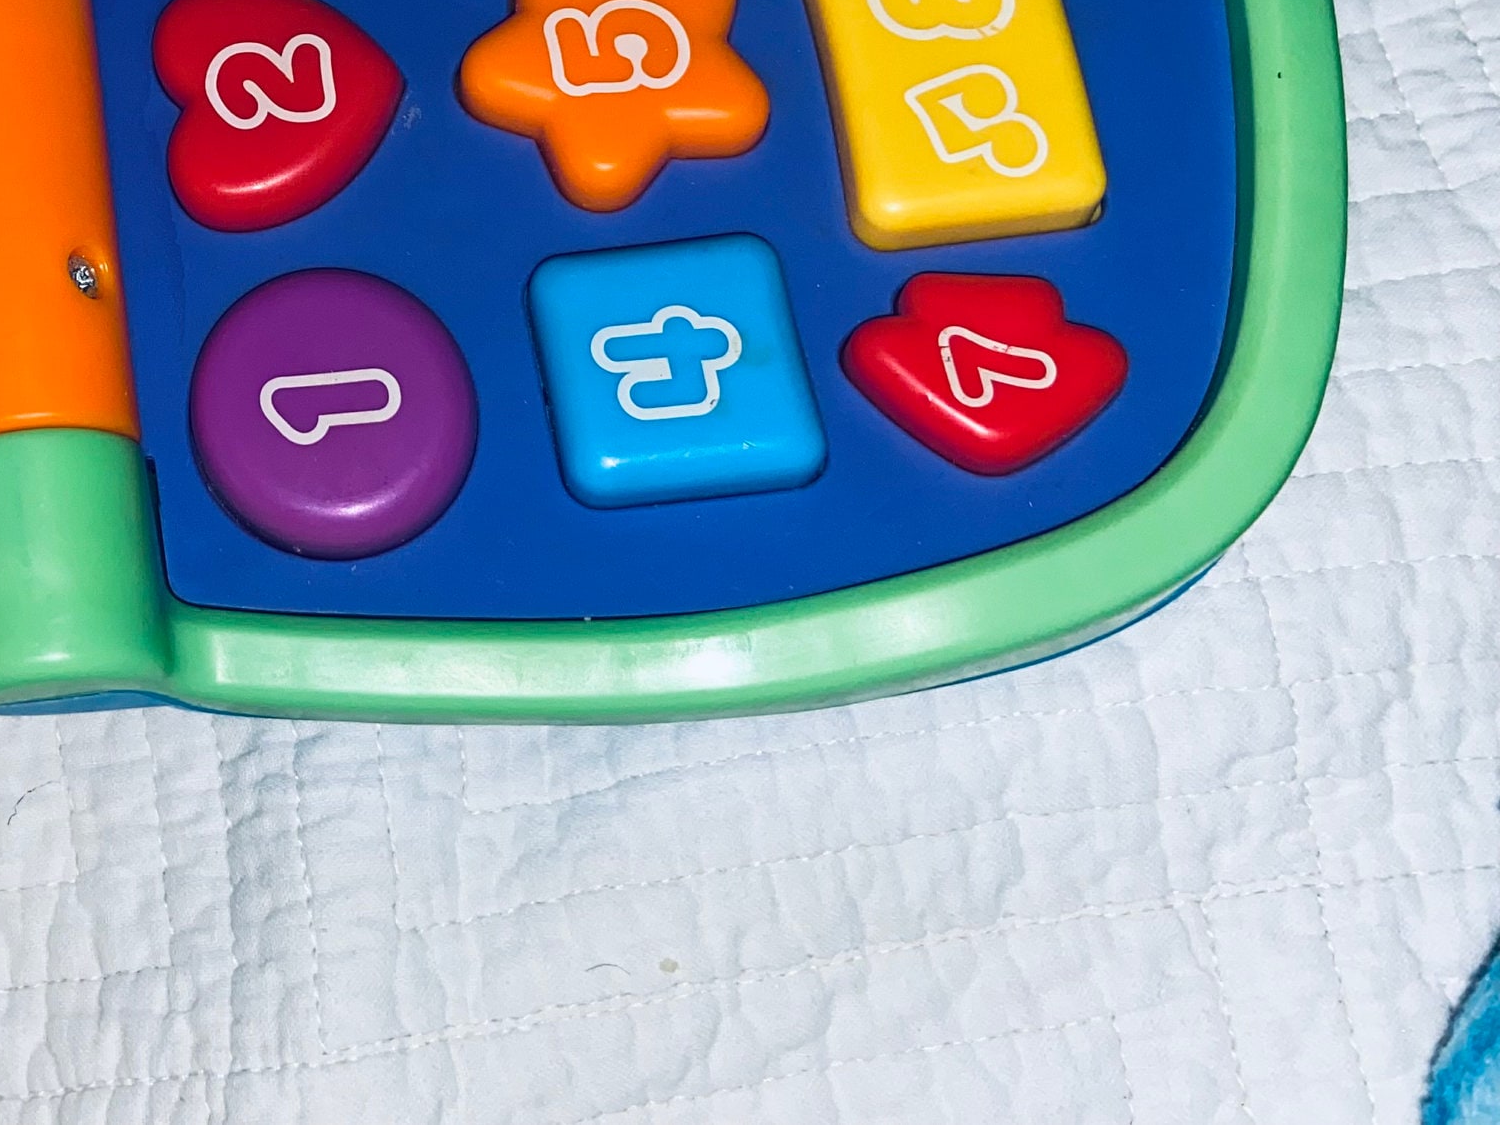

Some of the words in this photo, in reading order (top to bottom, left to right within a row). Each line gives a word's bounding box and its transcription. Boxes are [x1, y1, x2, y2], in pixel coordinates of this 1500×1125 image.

[204, 33, 336, 131] 2
[258, 367, 402, 446] 1
[589, 304, 743, 422] 4
[936, 324, 1058, 409] 7
